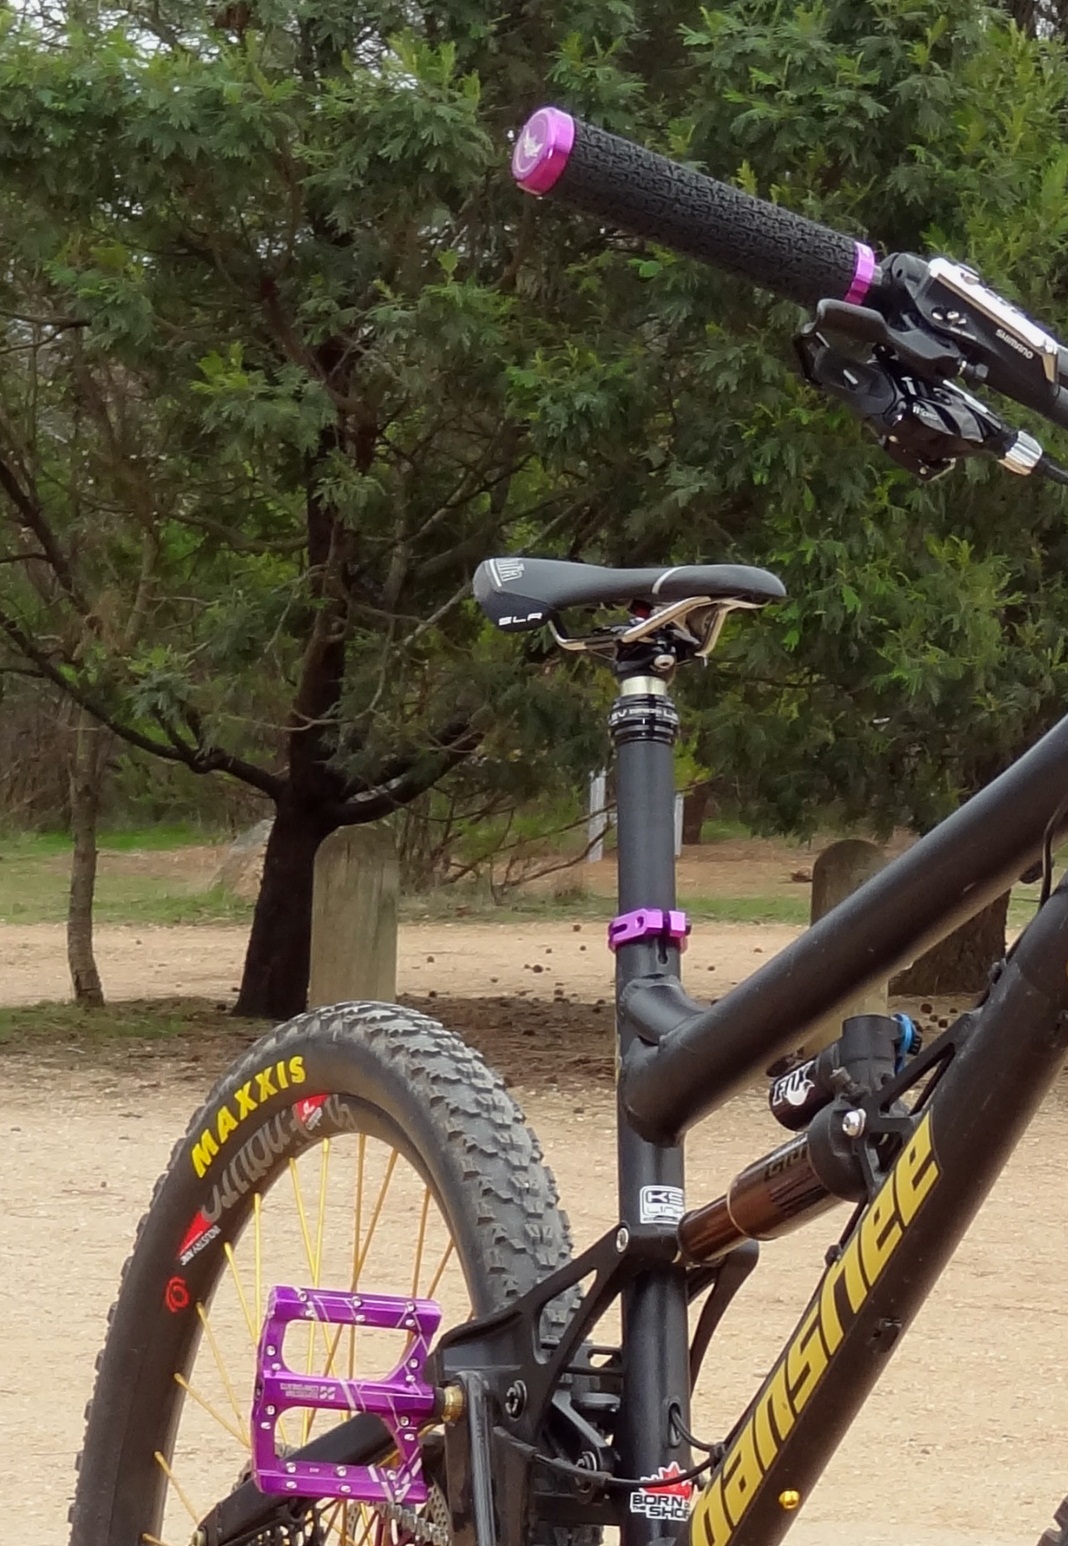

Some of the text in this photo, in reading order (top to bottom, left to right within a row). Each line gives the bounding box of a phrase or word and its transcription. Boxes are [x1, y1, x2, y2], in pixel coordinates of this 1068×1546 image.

[996, 328, 1034, 360] SHIMANO
[498, 612, 544, 627] SLR
[190, 1054, 307, 1179] MAXXIS
[632, 1494, 683, 1508] BORN
